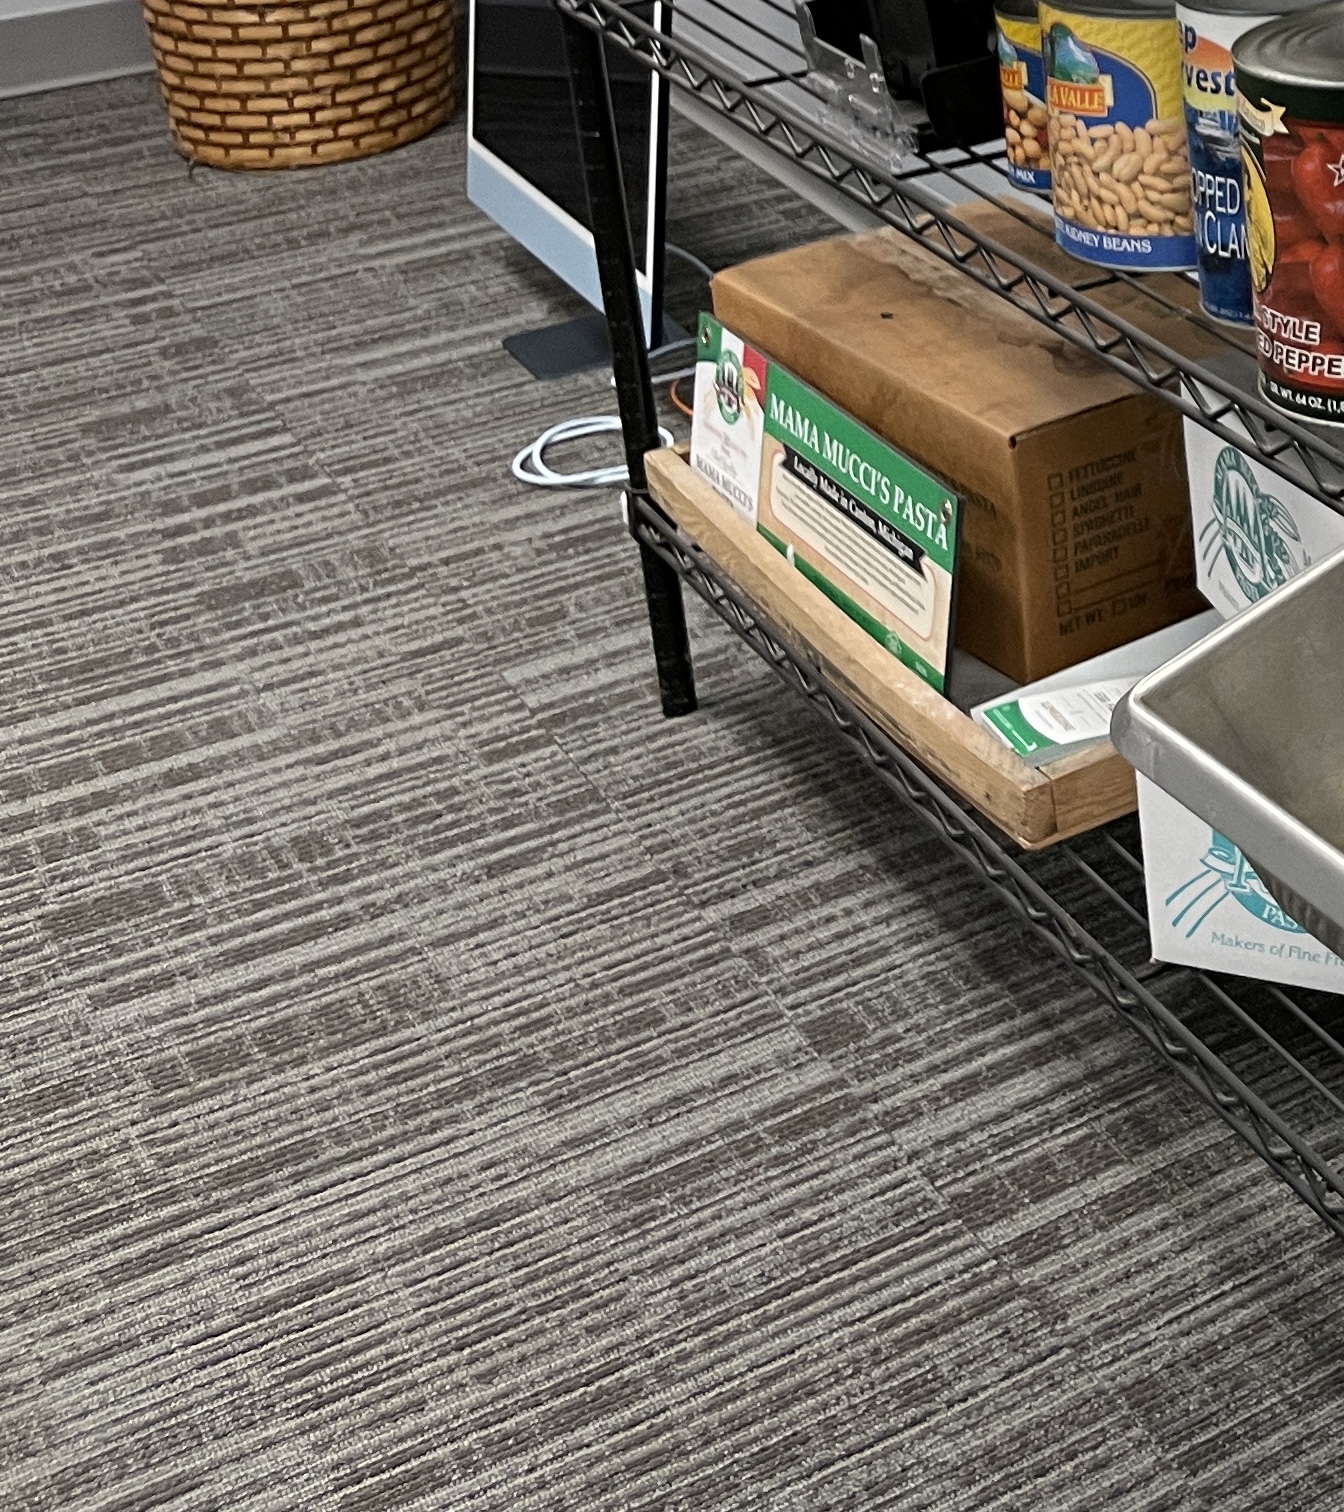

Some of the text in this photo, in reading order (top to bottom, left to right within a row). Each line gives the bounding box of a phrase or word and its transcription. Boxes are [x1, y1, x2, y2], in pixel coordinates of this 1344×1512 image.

[1187, 68, 1234, 96] vest
[1016, 168, 1036, 184] MIX
[1103, 235, 1152, 255] BEANS
[1261, 305, 1321, 346] STYLE
[1295, 392, 1307, 406] 64
[770, 392, 822, 455] MAMA
[822, 430, 891, 506] MUCCI'S
[893, 484, 949, 551] PASTA
[794, 454, 819, 489] Locally
[820, 471, 839, 499] Made
[876, 516, 915, 561] Michigan
[1072, 481, 1143, 521] ANGEL HAIR
[1210, 931, 1265, 954] Makers
[1269, 943, 1285, 958] of
[1288, 945, 1320, 964] Fine
